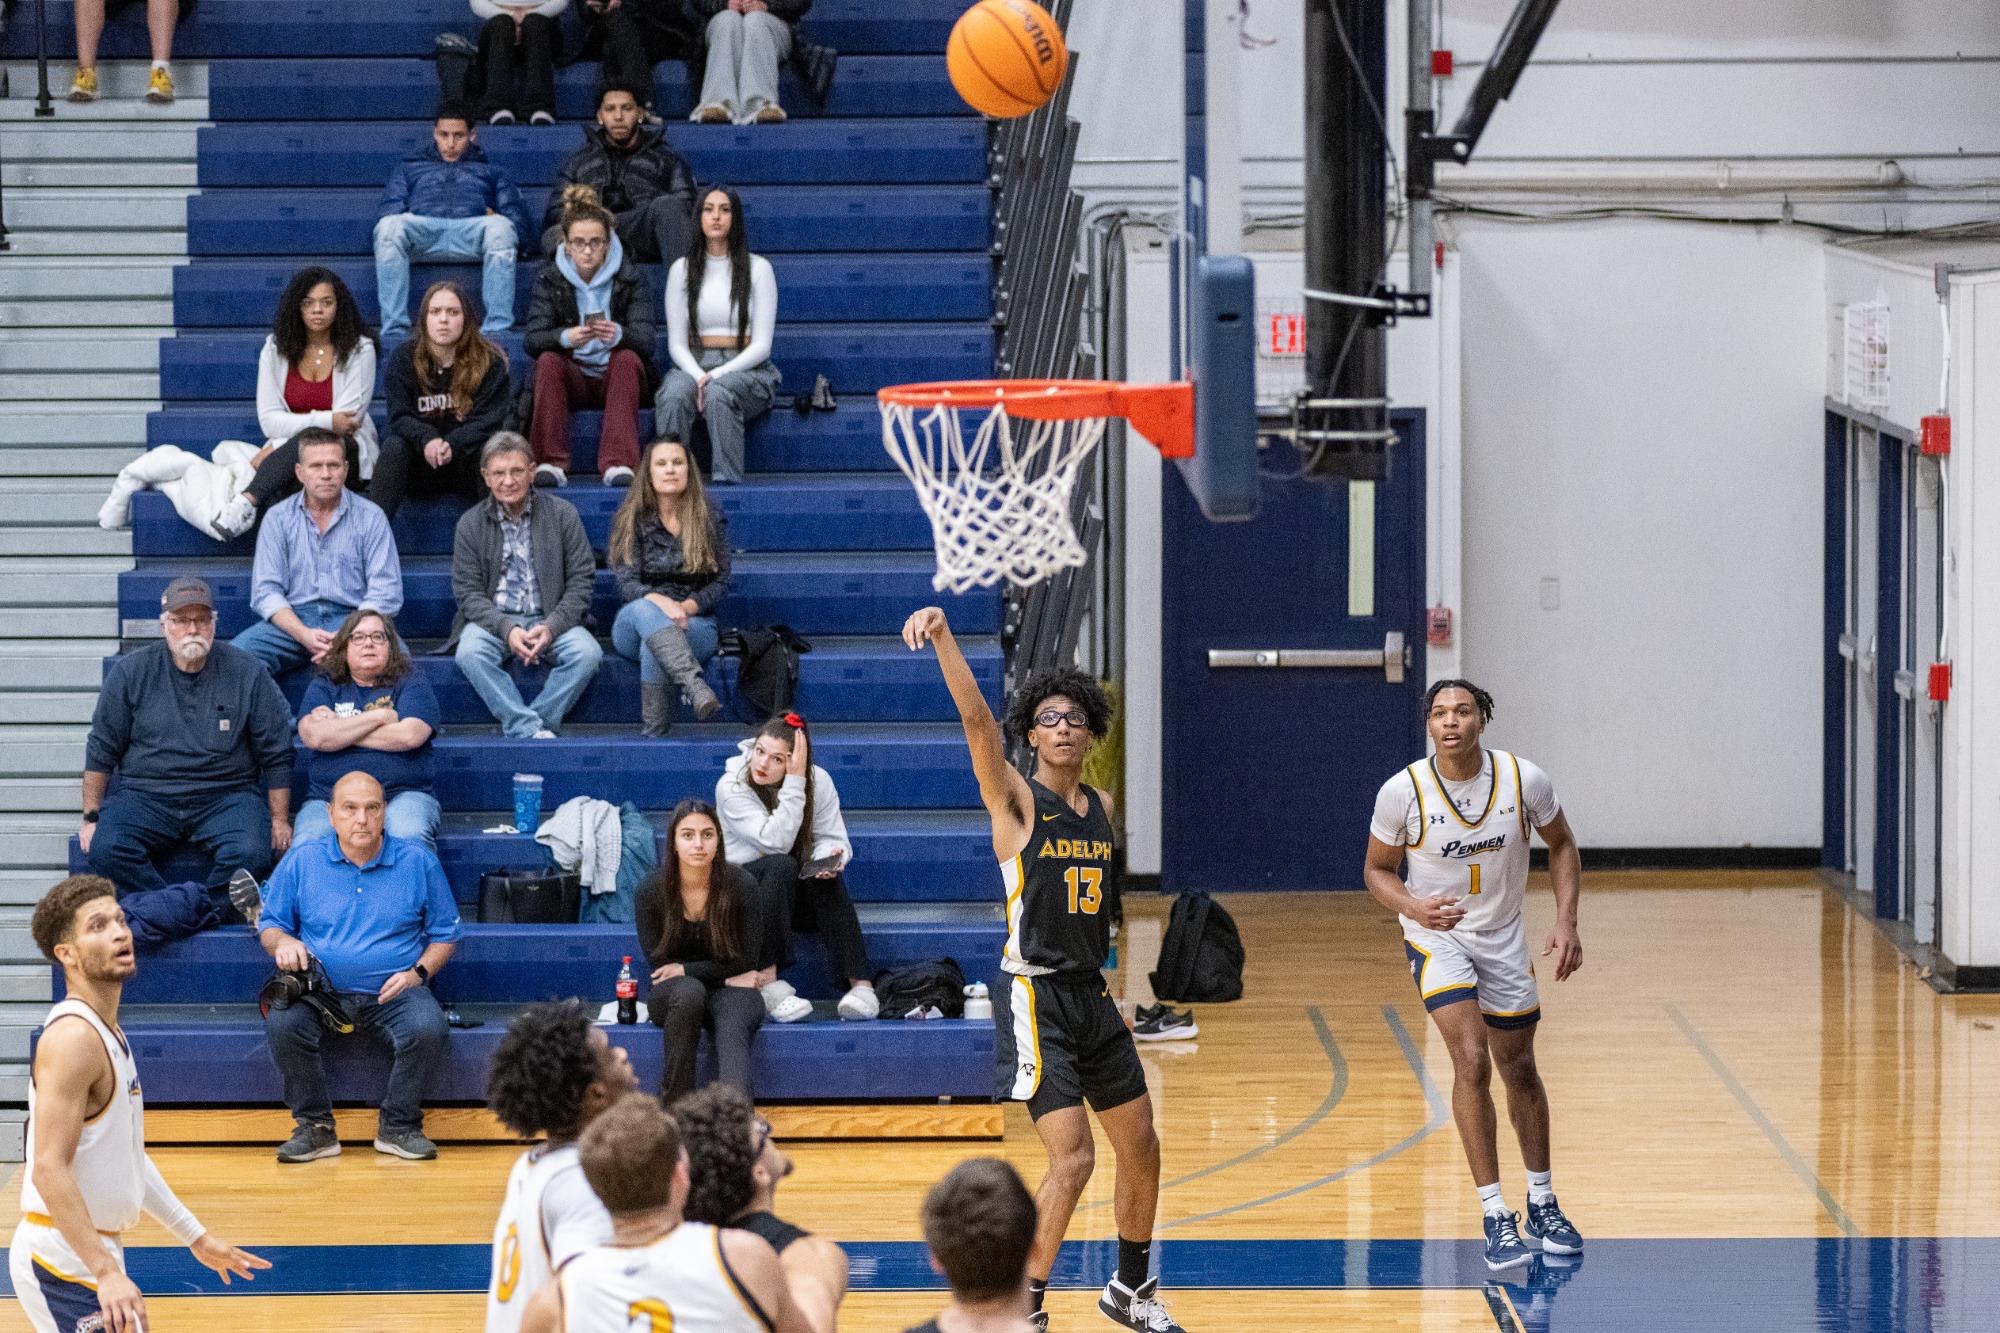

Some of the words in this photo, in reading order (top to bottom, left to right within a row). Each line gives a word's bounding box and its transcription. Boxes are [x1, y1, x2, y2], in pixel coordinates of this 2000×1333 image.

[1271, 314, 1306, 353] EXI
[1038, 837, 1112, 862] ADELPH
[1064, 866, 1103, 915] 13
[1467, 863, 1481, 895] 1
